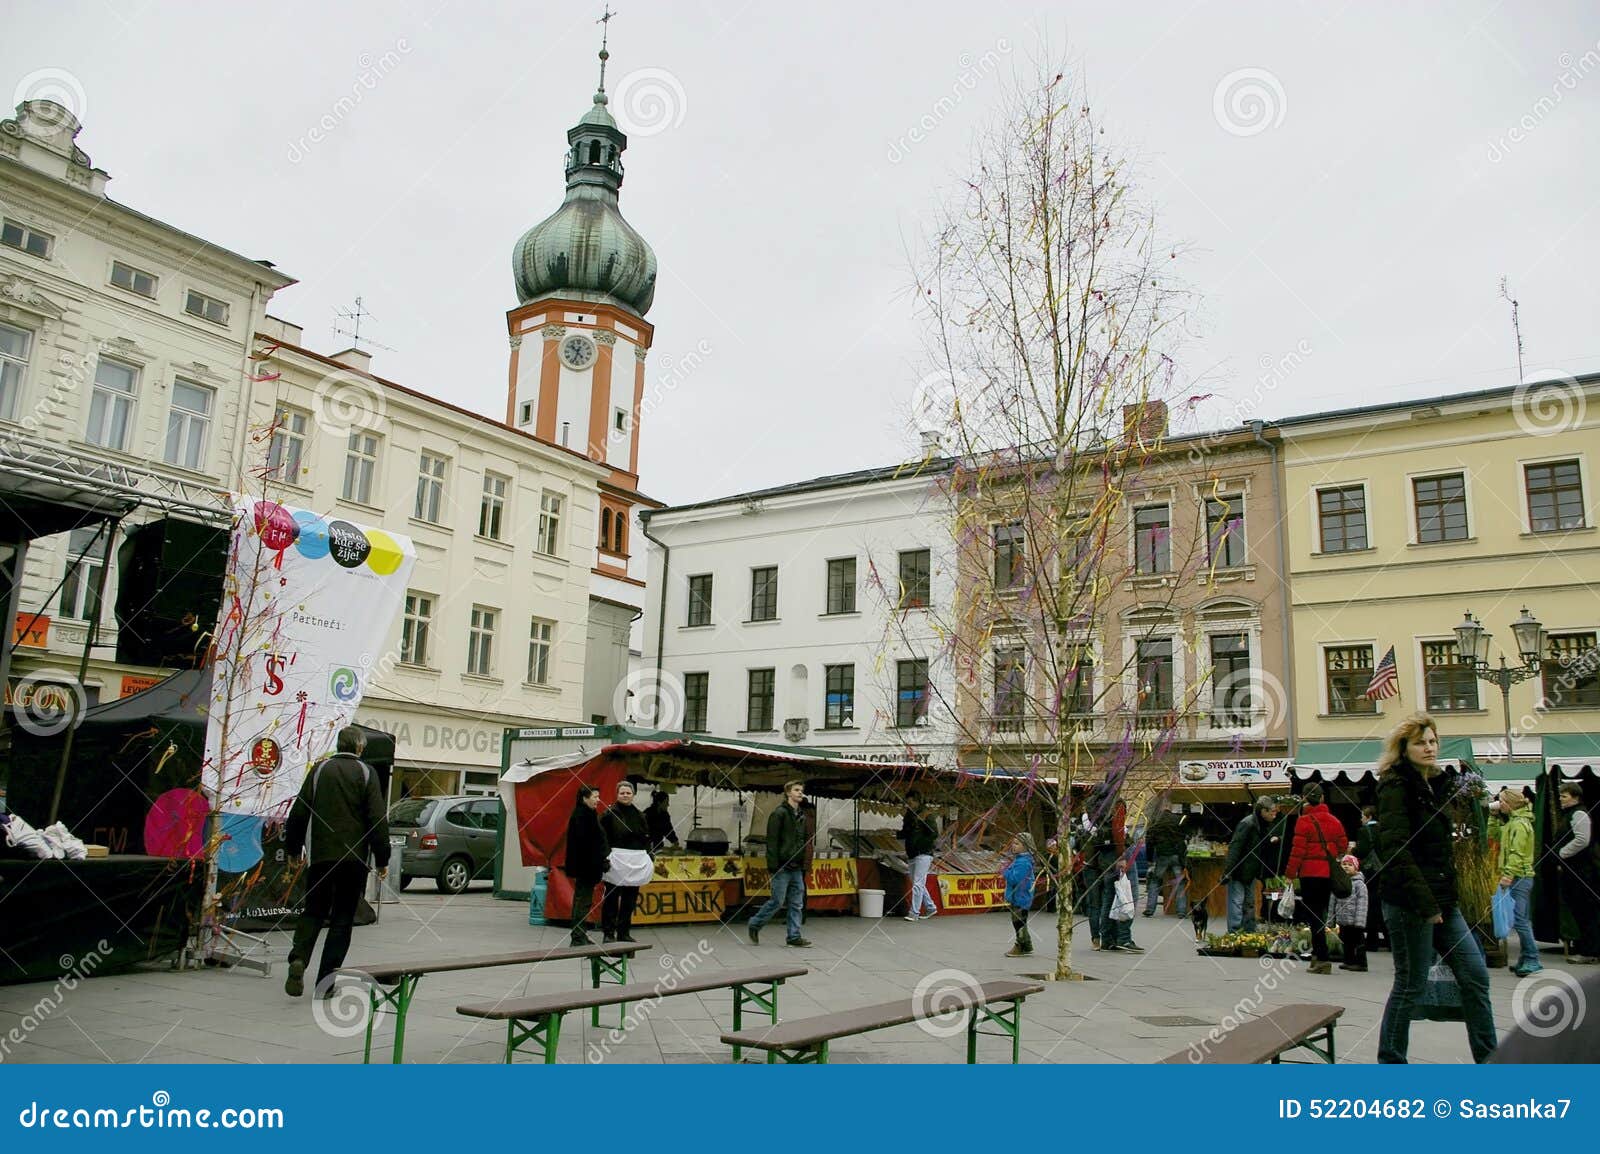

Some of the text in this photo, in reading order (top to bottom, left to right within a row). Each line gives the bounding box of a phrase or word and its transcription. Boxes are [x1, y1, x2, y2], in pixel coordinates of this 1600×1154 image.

[334, 536, 367, 551] kde se
[337, 546, 360, 561] žije!
[1256, 760, 1284, 768] MEDY
